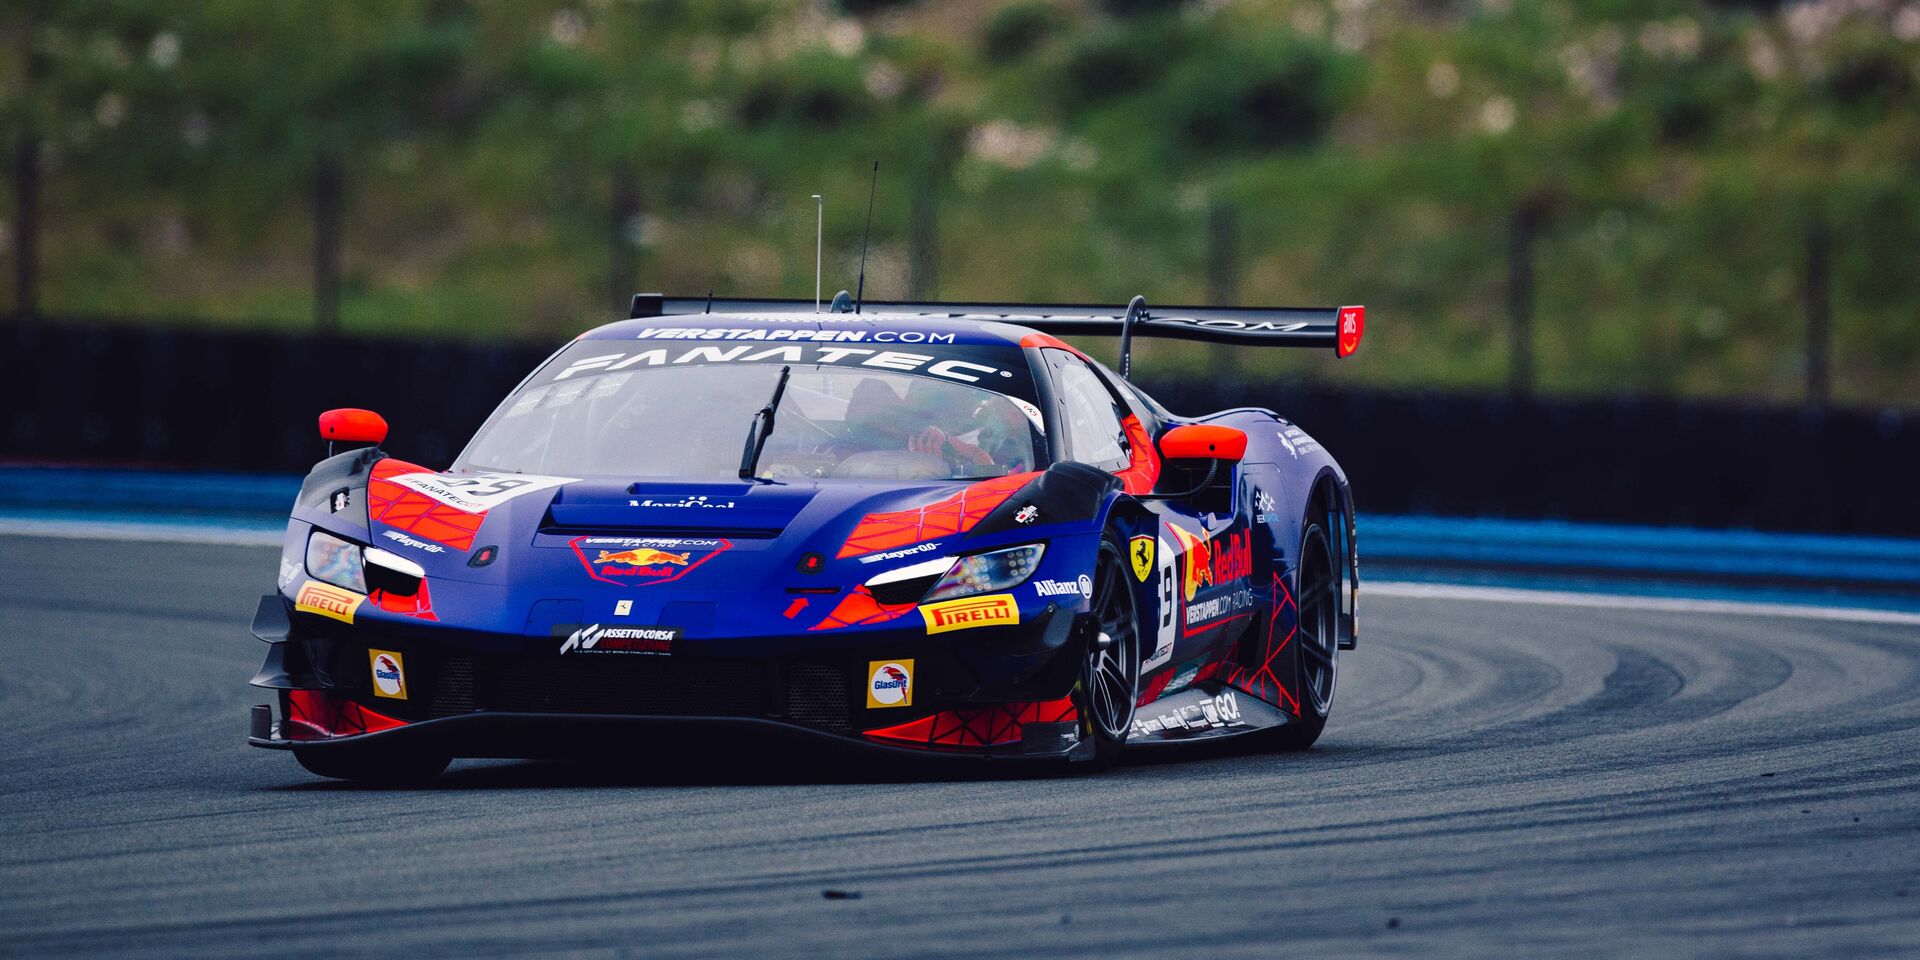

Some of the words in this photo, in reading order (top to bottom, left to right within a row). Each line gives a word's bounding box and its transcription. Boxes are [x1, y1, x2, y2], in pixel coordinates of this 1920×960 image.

[1344, 312, 1356, 335] aws
[637, 328, 956, 344] VERSTAPPEN.COM
[553, 345, 998, 382] FANATEC
[586, 538, 718, 546] VERSTAPPEN.COM
[601, 566, 637, 576] Red
[638, 566, 673, 577] Bull
[1033, 579, 1080, 597] Allianz
[300, 586, 354, 616] PIRELLI
[932, 599, 1011, 627] PIRELLI
